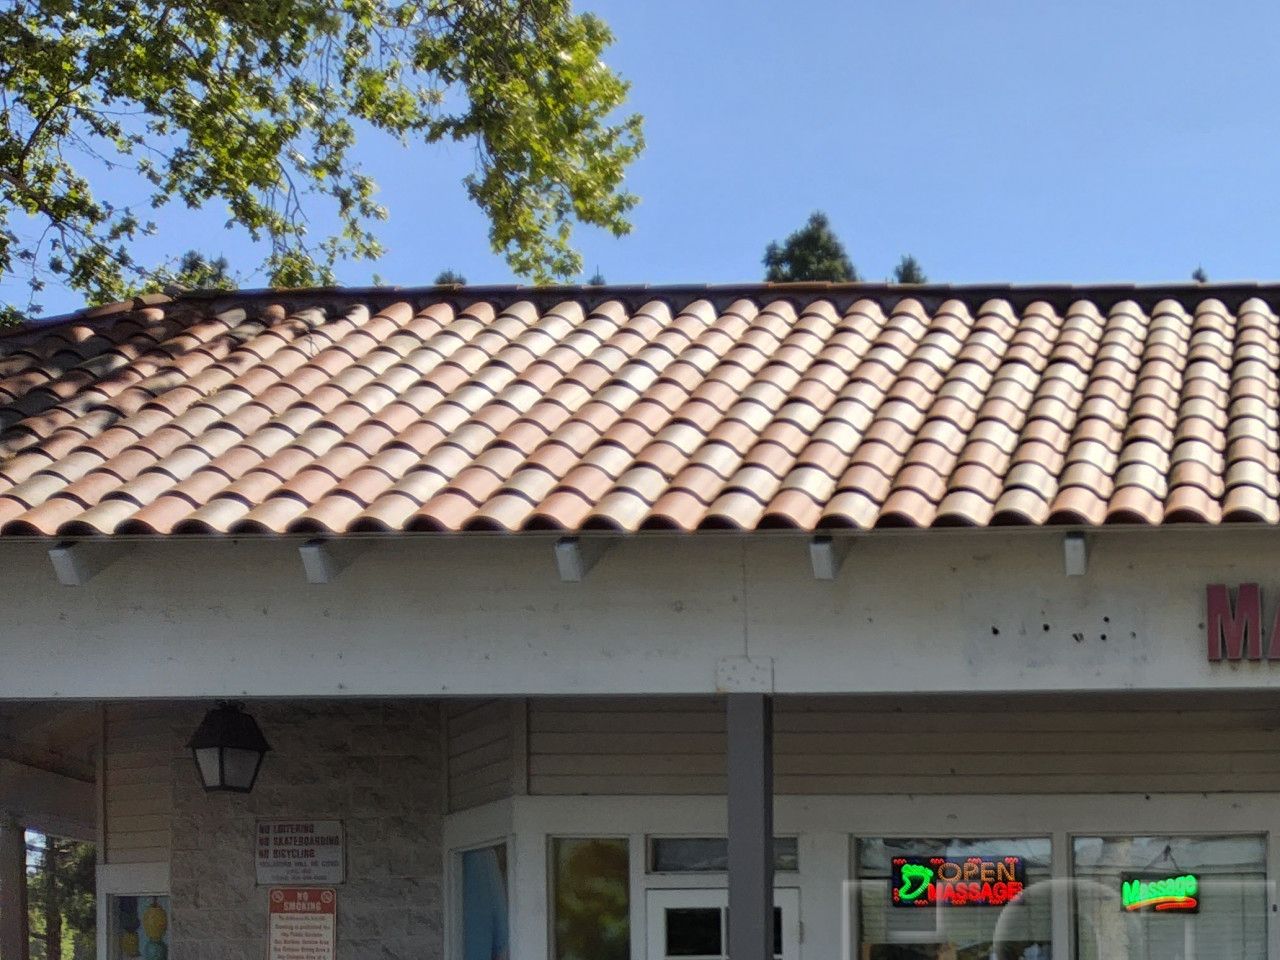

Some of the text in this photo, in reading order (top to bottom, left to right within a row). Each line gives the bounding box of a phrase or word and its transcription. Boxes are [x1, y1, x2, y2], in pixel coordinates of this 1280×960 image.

[273, 824, 314, 834] LOITERING
[273, 835, 340, 846] SKATEBOARDING
[273, 849, 315, 859] BICYCLING
[937, 862, 1016, 883] OPEN
[928, 881, 1021, 901] MASSAGE
[1122, 874, 1198, 906] Massage
[296, 891, 309, 901] NO
[283, 902, 322, 911] SMOKING
